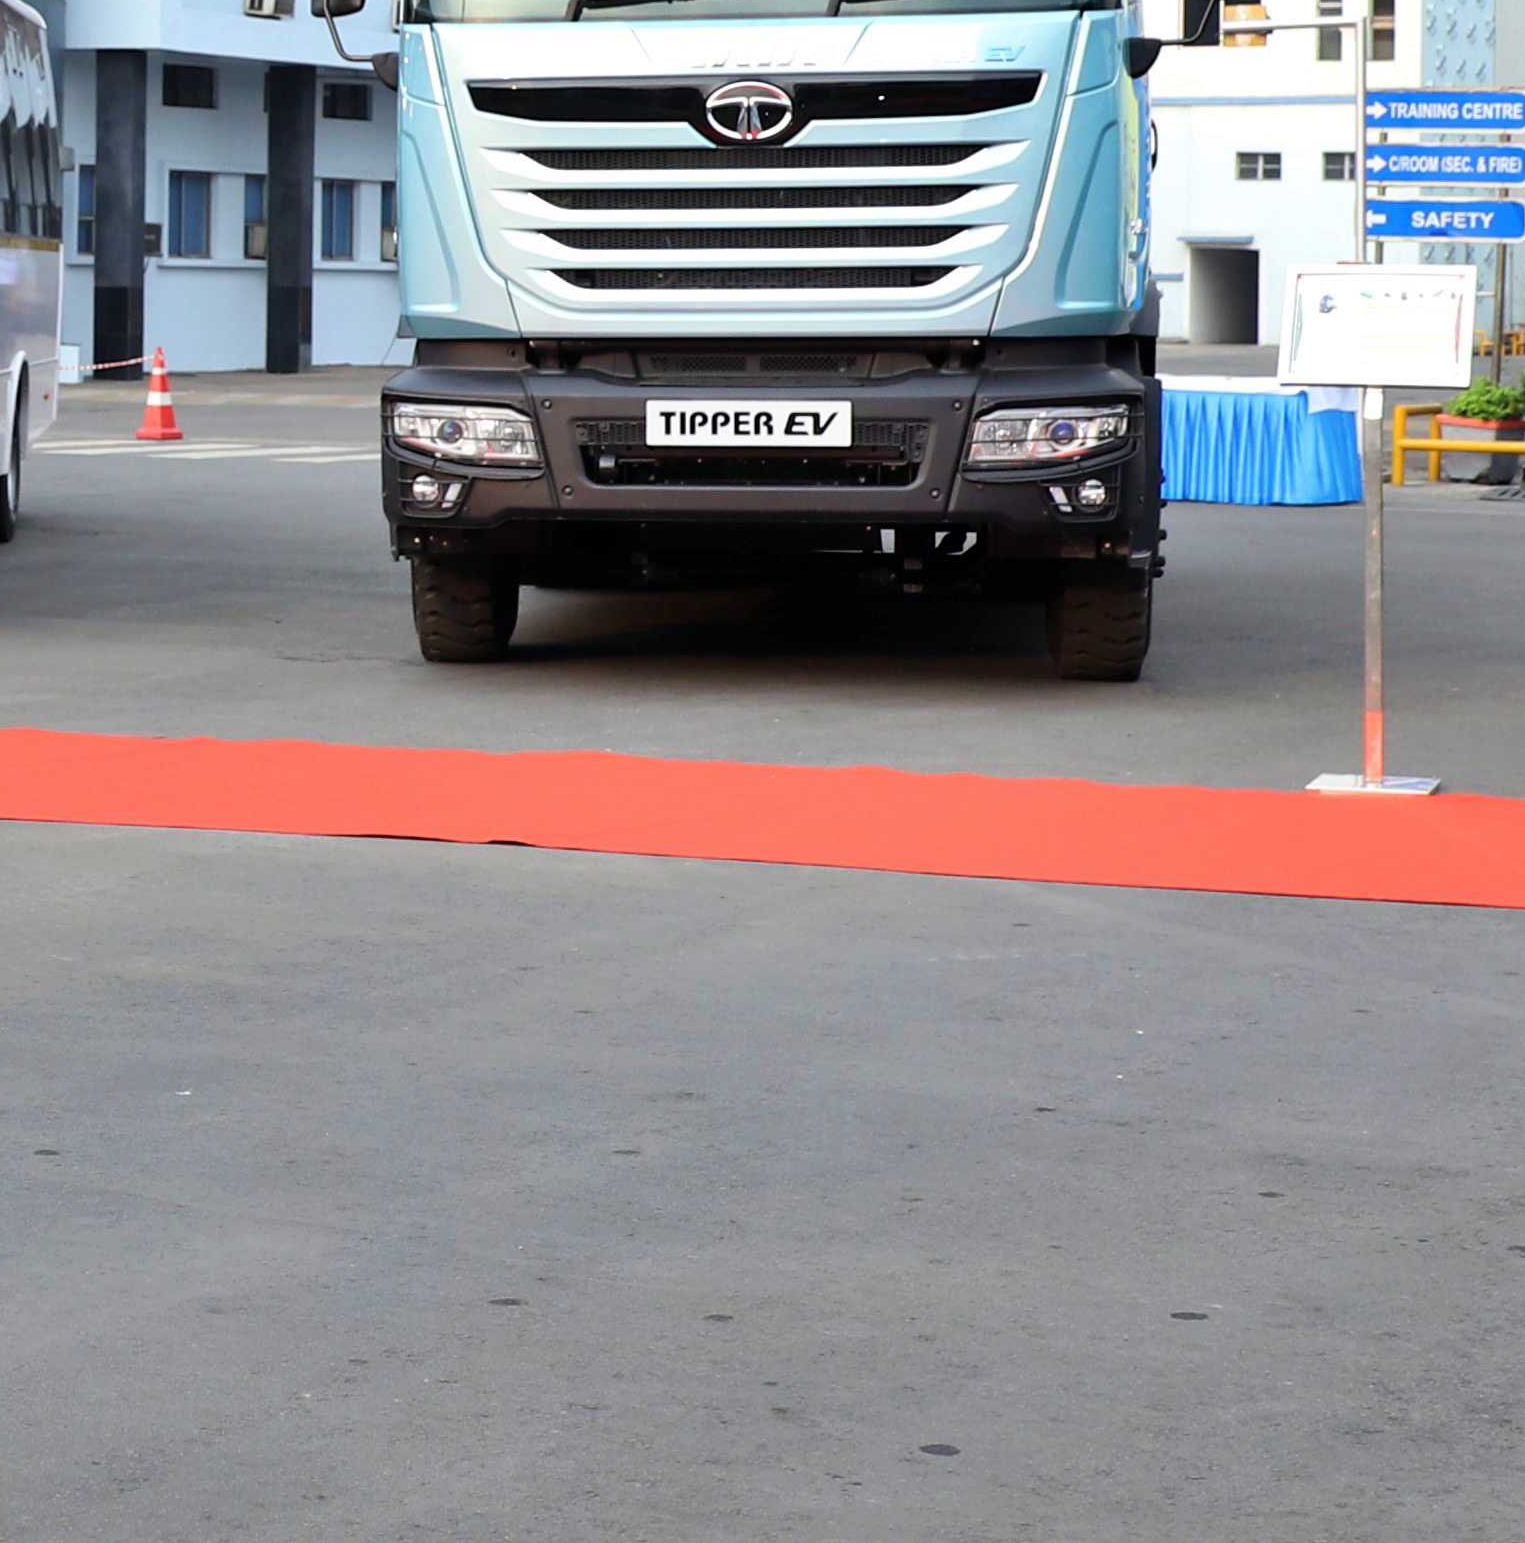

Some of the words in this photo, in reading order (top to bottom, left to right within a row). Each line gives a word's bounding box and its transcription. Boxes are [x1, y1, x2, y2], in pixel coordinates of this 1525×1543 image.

[1389, 102, 1460, 120] TRAINING
[1462, 102, 1523, 120] CENTRE
[1477, 156, 1487, 173] &
[1489, 156, 1522, 174] FIRE)
[1411, 210, 1495, 229] SAFETY
[659, 411, 774, 436] TIPPER
[784, 411, 839, 436] EV
